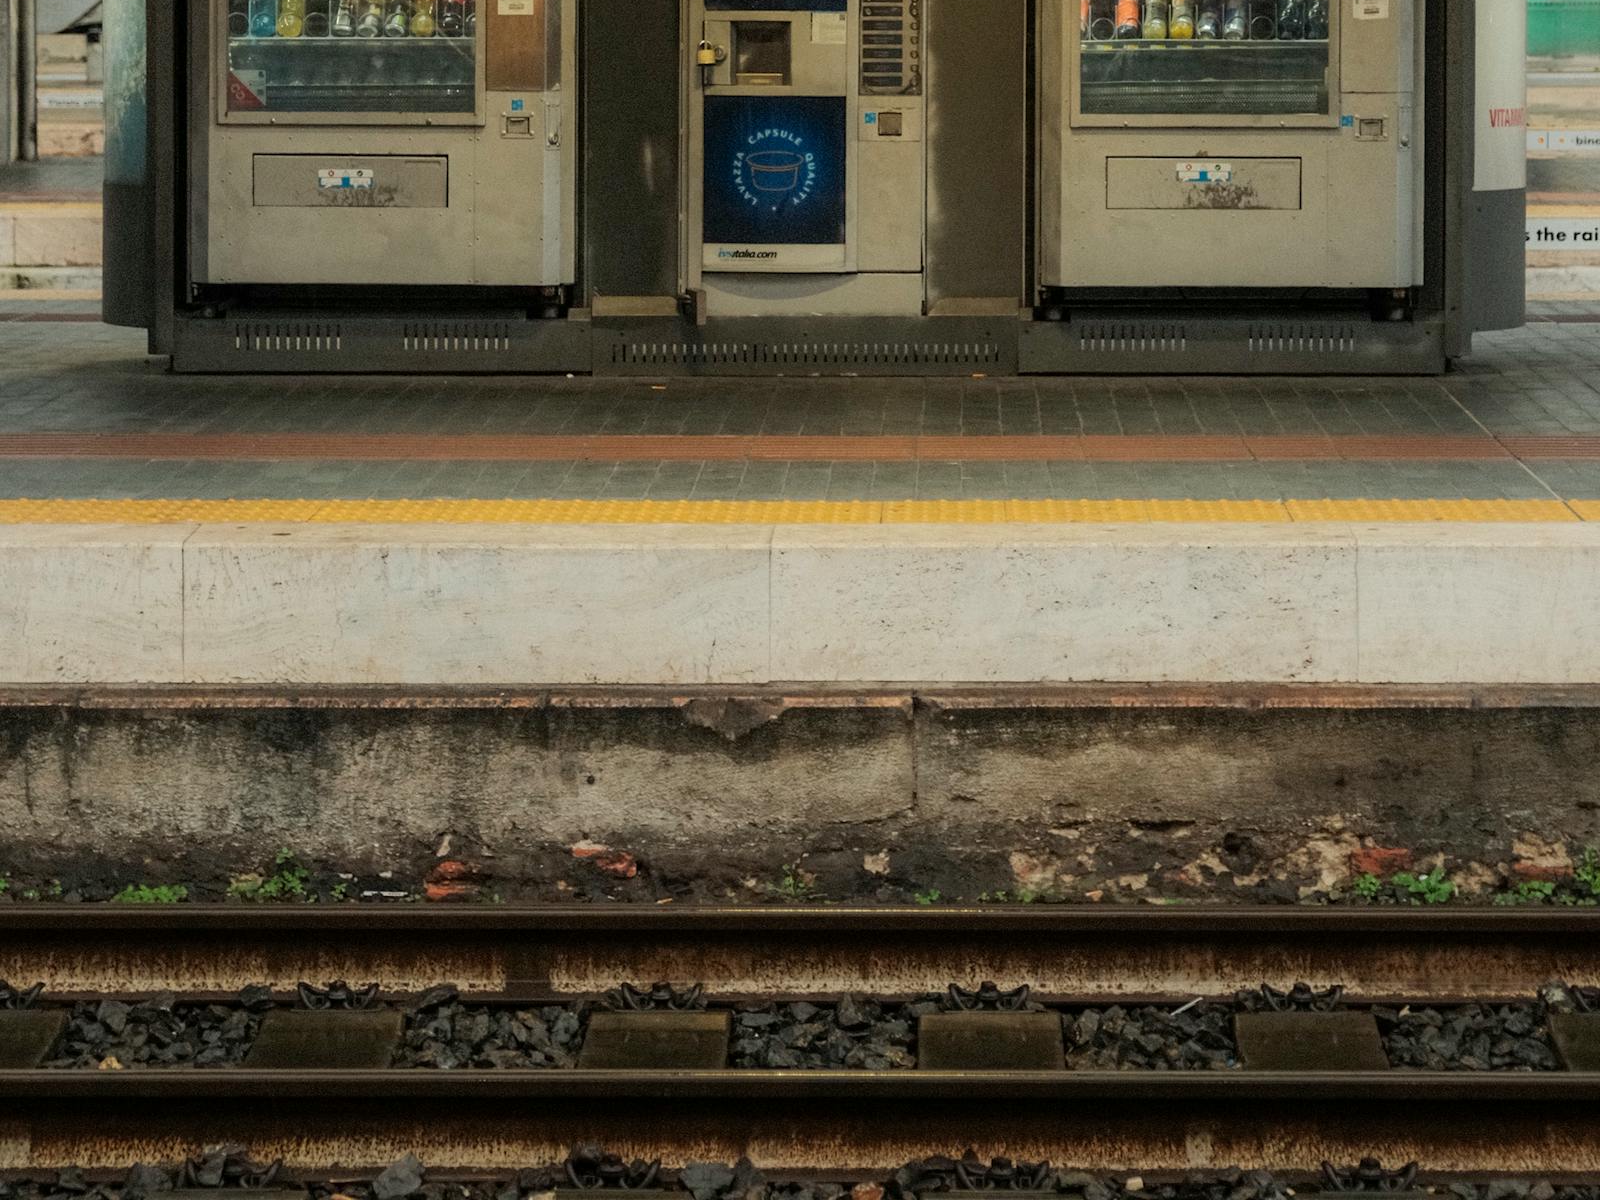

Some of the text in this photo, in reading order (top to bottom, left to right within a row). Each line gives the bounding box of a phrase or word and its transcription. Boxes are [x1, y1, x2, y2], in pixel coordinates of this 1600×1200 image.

[747, 128, 803, 146] CAPSULE
[732, 152, 758, 206] LAVAZZA
[792, 152, 816, 206] QUALITY
[1536, 226, 1567, 241] the
